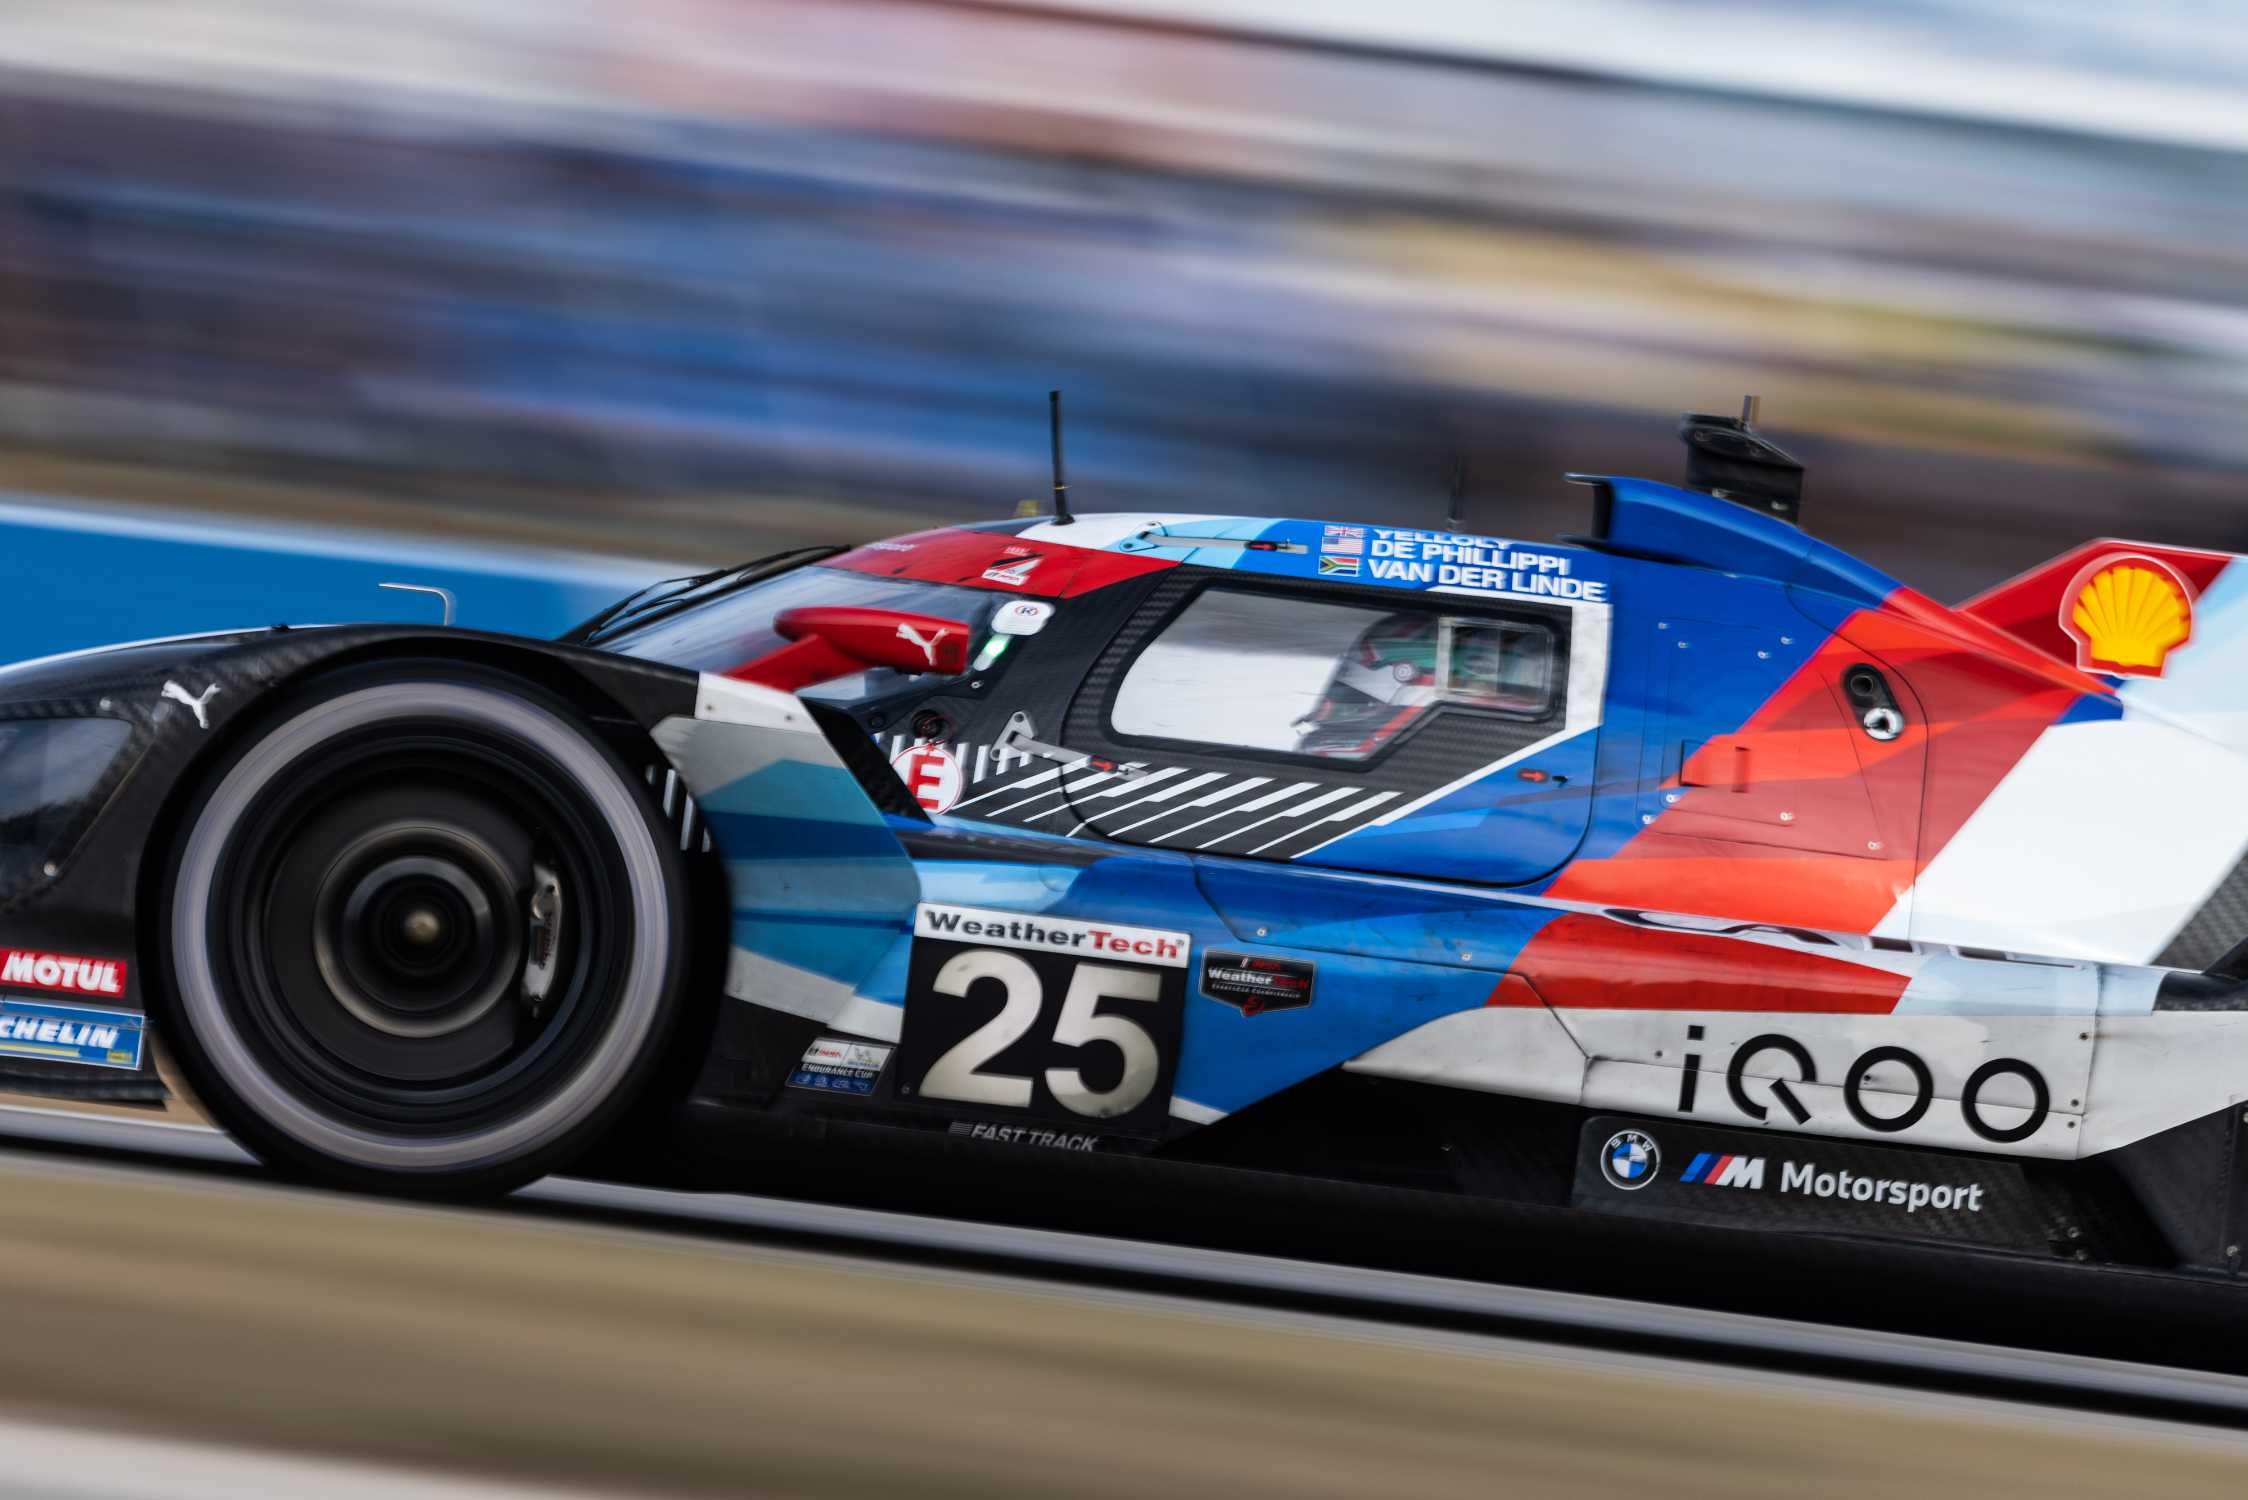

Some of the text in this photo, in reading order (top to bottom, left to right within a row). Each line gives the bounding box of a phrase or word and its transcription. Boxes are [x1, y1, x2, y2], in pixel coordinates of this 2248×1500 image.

[1371, 539, 1571, 576] DE PHILLIPPI
[1368, 559, 1609, 602] VAN DER LINDE
[908, 754, 945, 810] E
[1, 952, 121, 993] MOTUL
[918, 949, 1160, 1119] 25
[971, 1122, 1099, 1152] FAST TRACK
[1610, 1134, 1653, 1152] BMW
[1781, 1161, 1985, 1213] Motorsport
